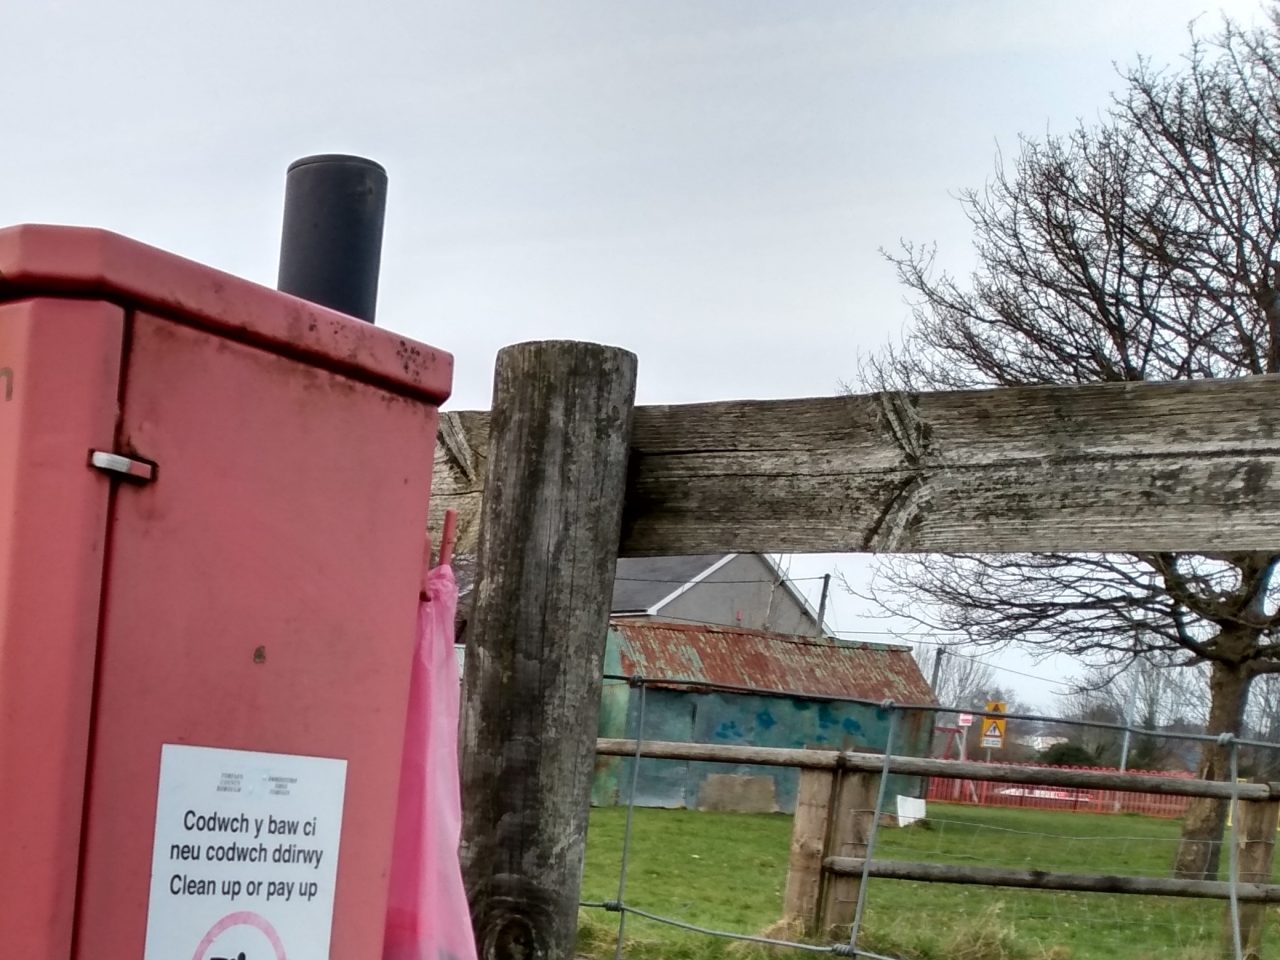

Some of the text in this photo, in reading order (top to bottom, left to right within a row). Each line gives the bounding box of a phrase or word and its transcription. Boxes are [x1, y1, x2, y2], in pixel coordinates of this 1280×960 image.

[184, 809, 317, 839] Codwch y baw ci
[170, 842, 323, 869] neu codwch ddirwy
[170, 874, 318, 901] Clean up or pay up
